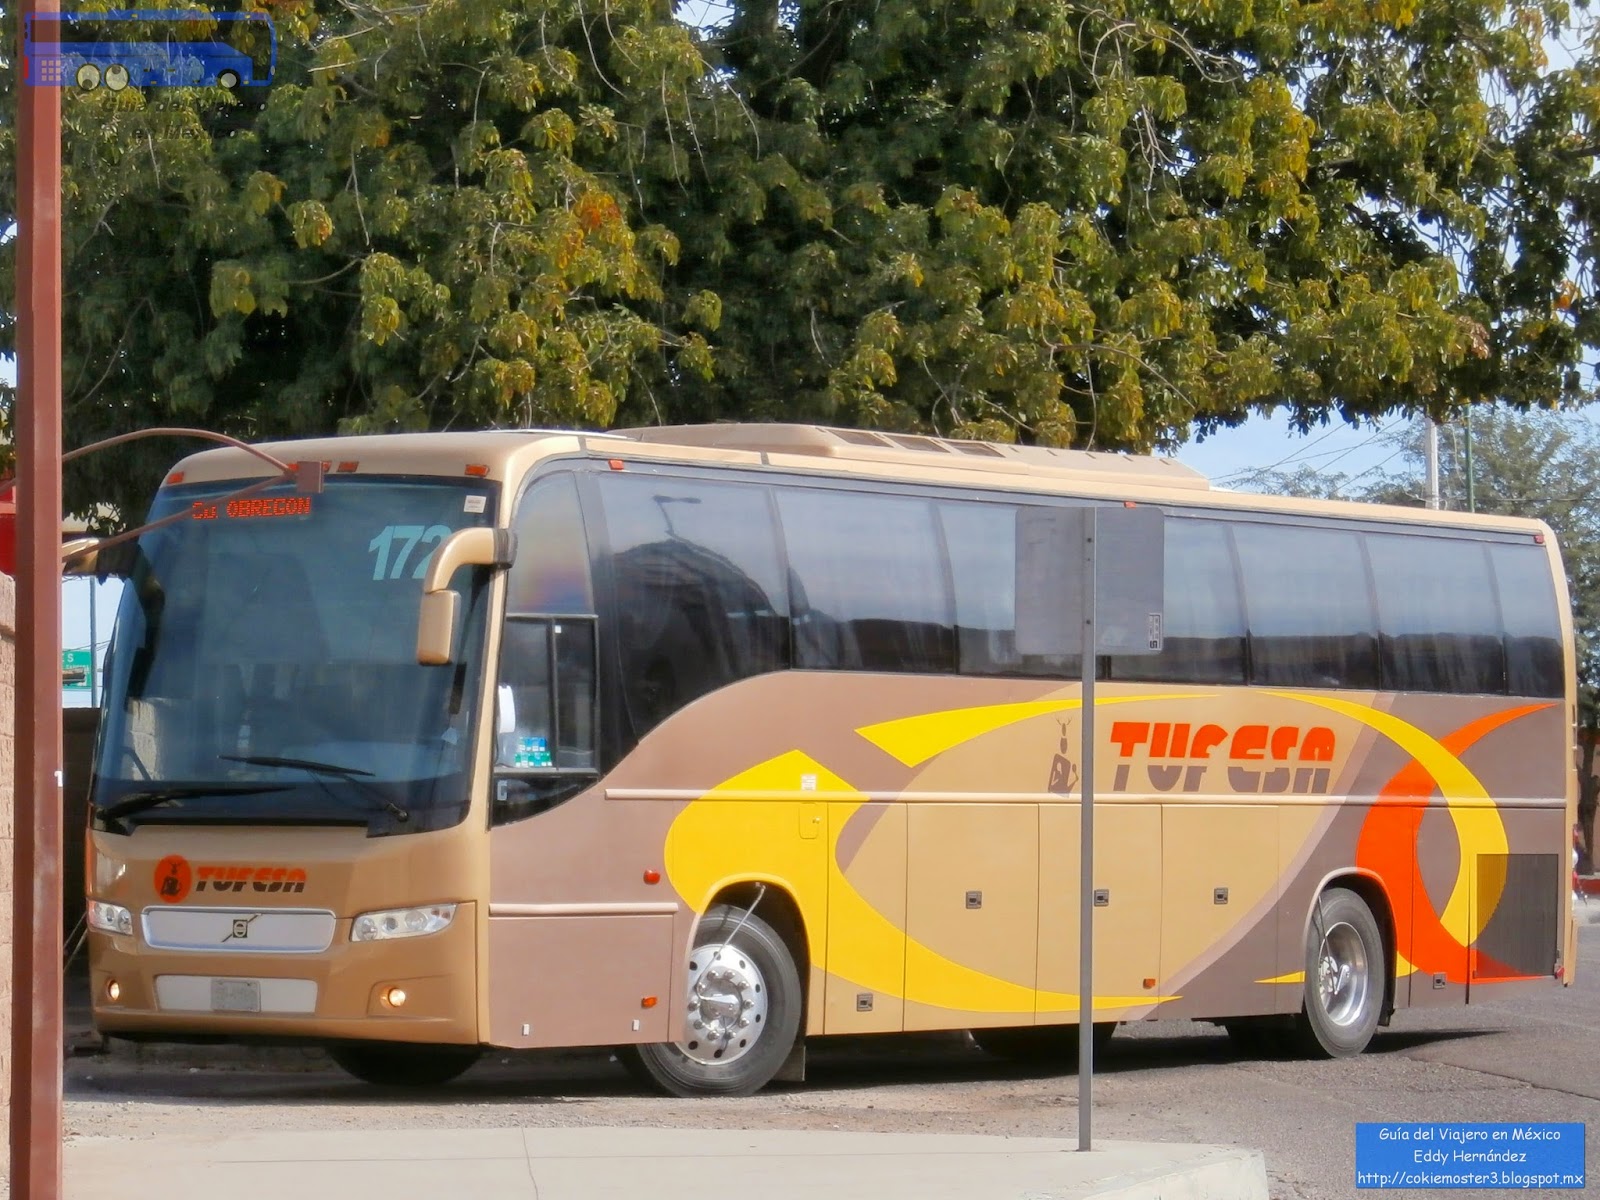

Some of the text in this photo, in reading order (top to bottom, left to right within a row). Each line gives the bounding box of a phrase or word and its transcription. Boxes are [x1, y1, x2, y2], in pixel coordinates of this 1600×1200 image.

[226, 497, 311, 518] OBREGON
[367, 524, 453, 581] 172
[1110, 721, 1336, 794] TUFESA
[195, 866, 307, 893] TUFESA
